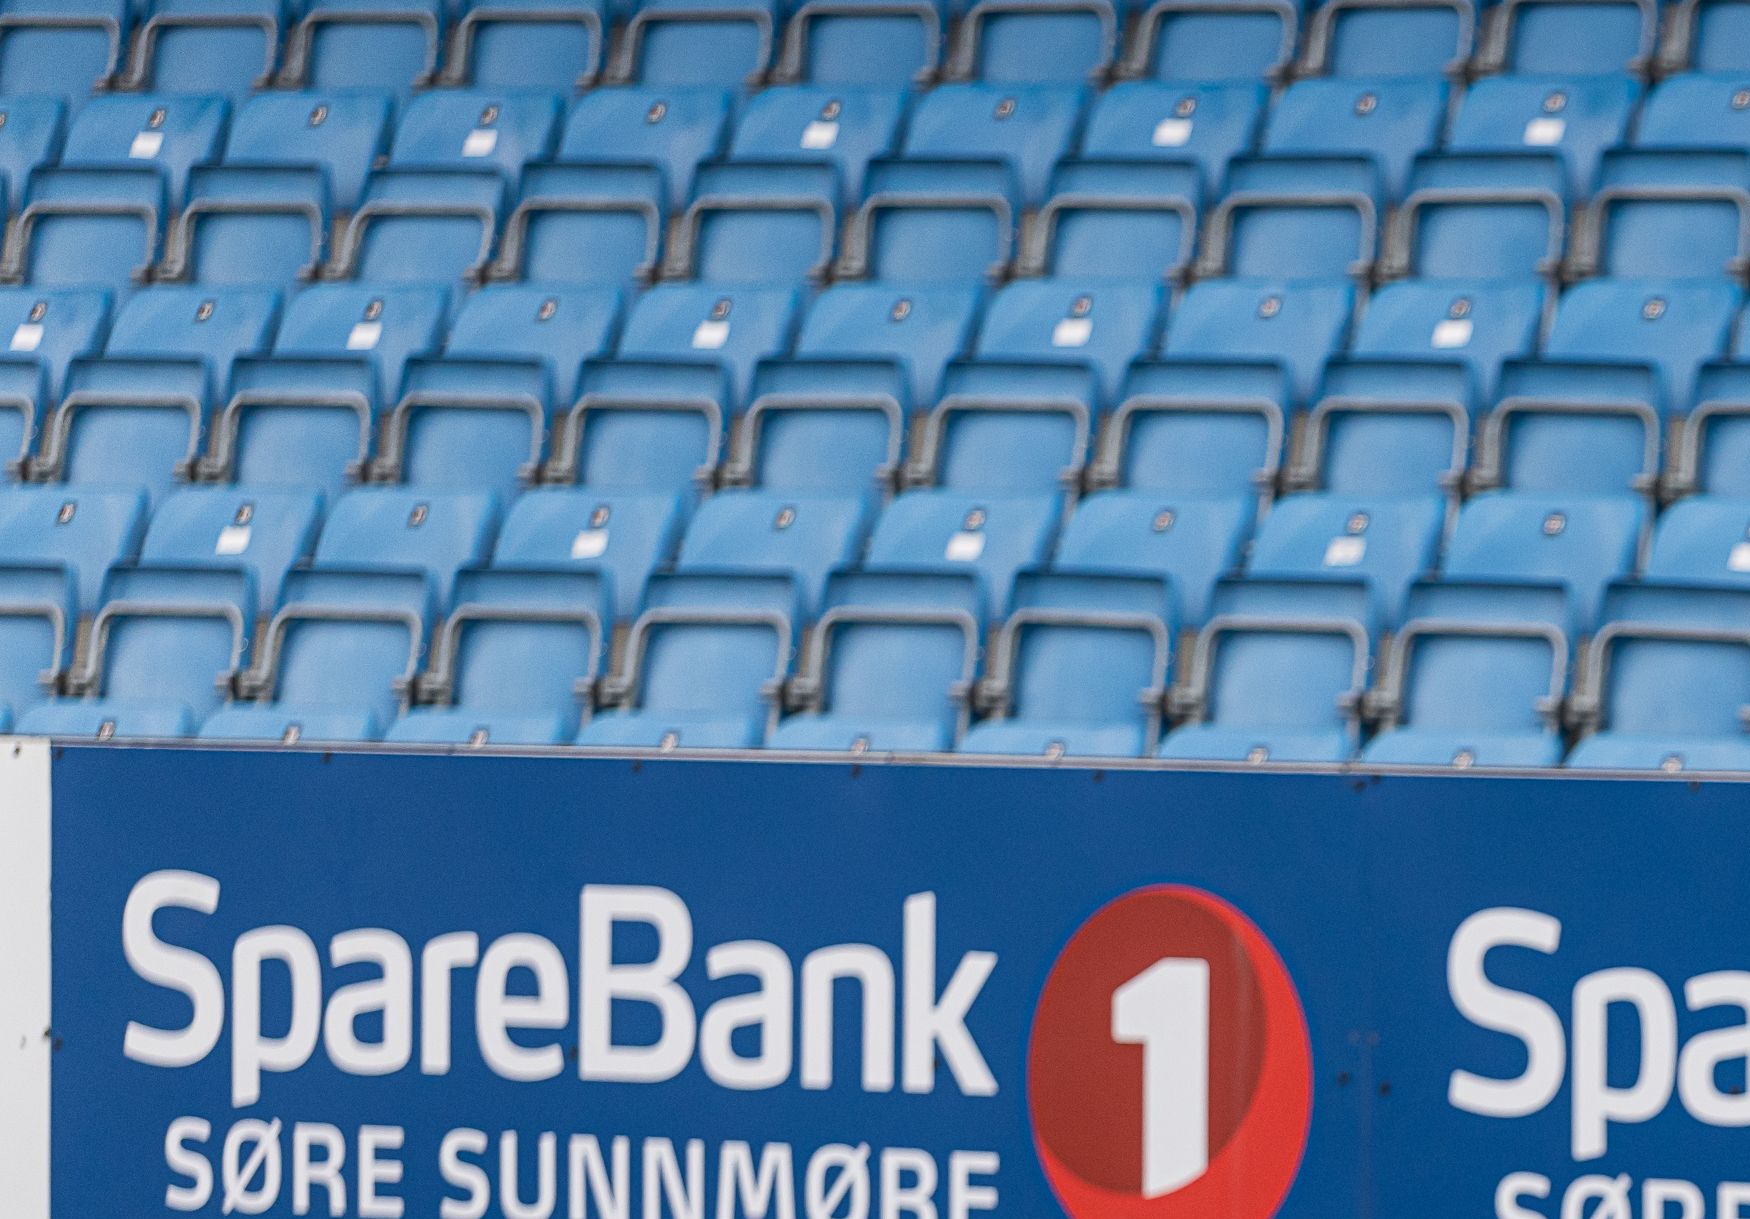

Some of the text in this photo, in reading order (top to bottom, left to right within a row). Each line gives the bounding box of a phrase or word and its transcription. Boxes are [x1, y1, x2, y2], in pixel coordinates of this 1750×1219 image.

[121, 868, 999, 1108] SpareBank
[1110, 956, 1211, 1200] 1
[164, 1115, 405, 1219] SØRE
